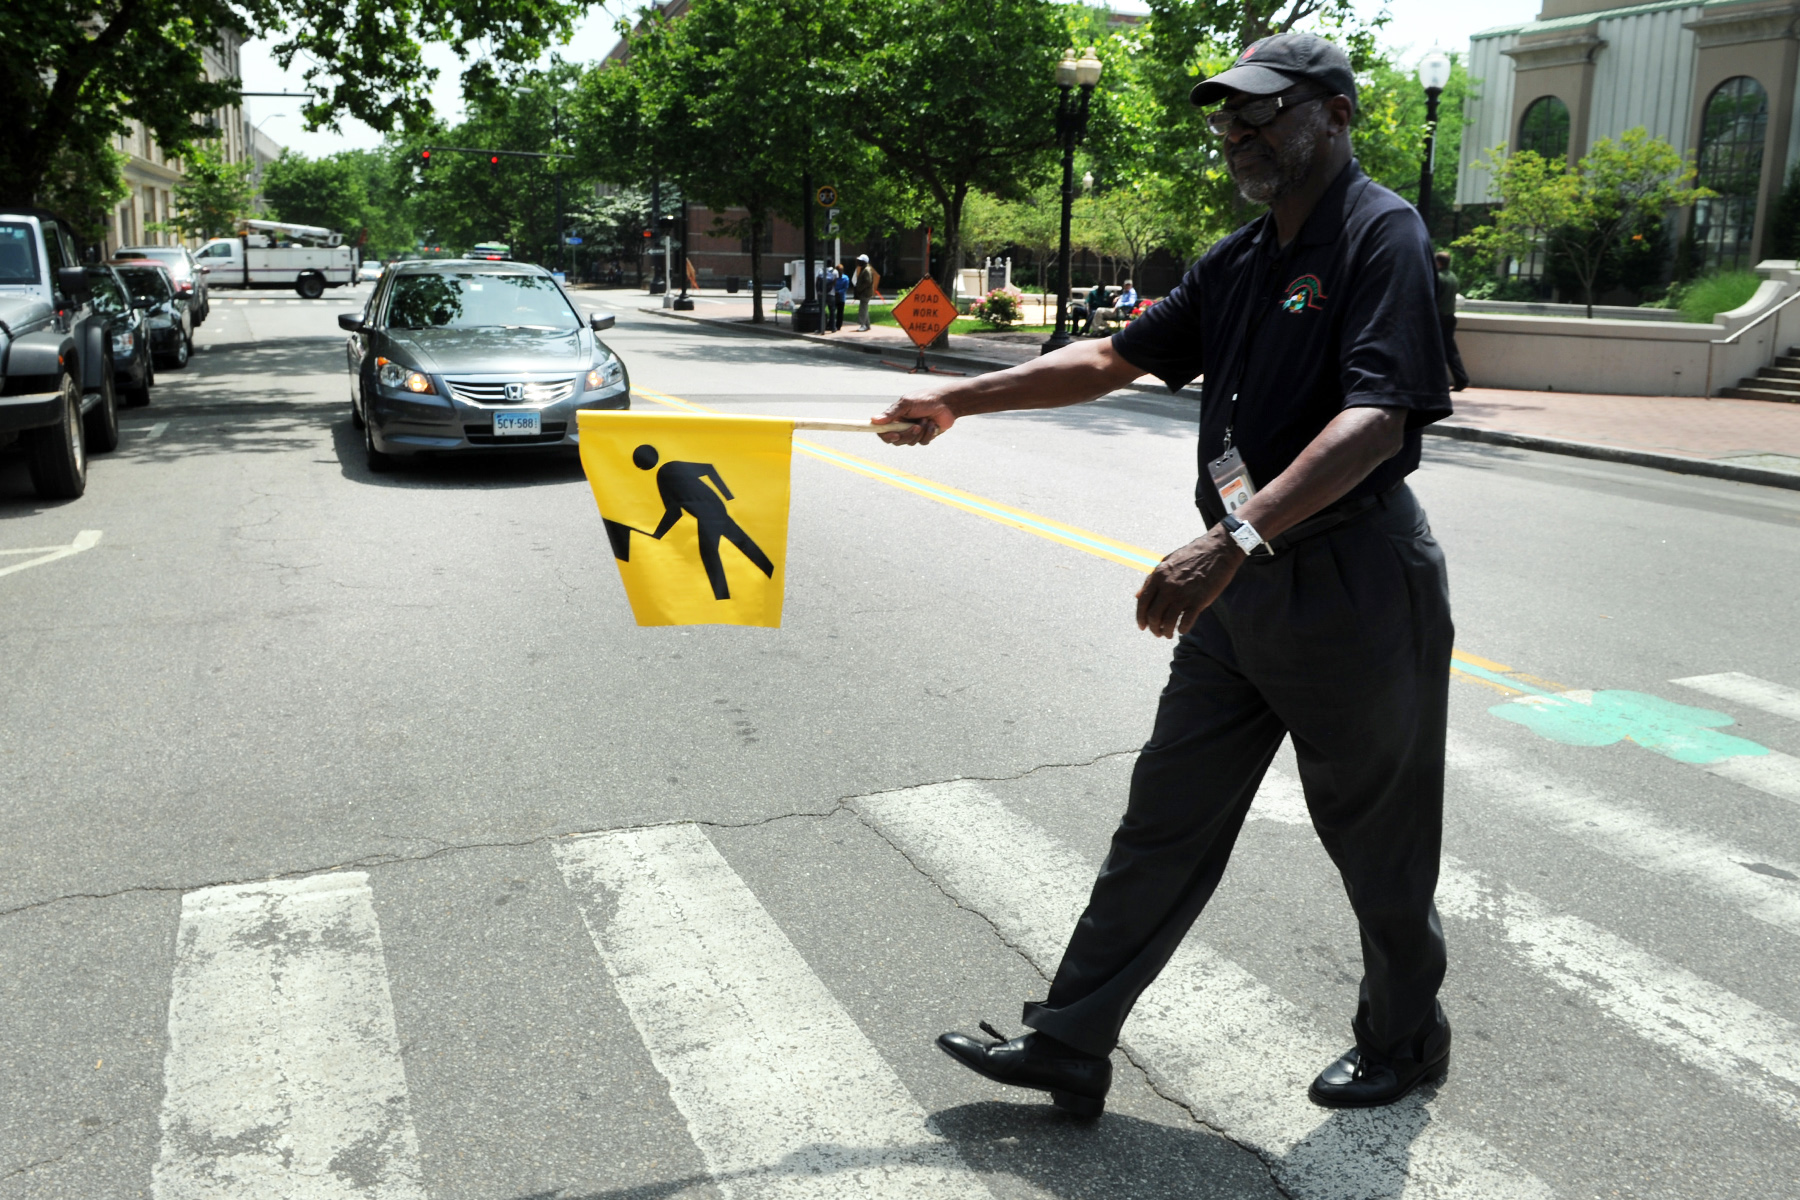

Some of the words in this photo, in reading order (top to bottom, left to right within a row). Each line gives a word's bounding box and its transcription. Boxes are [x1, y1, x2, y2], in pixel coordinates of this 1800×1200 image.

[914, 294, 939, 304] ROAD
[912, 308, 938, 318] WORK
[908, 322, 940, 332] AHEAD
